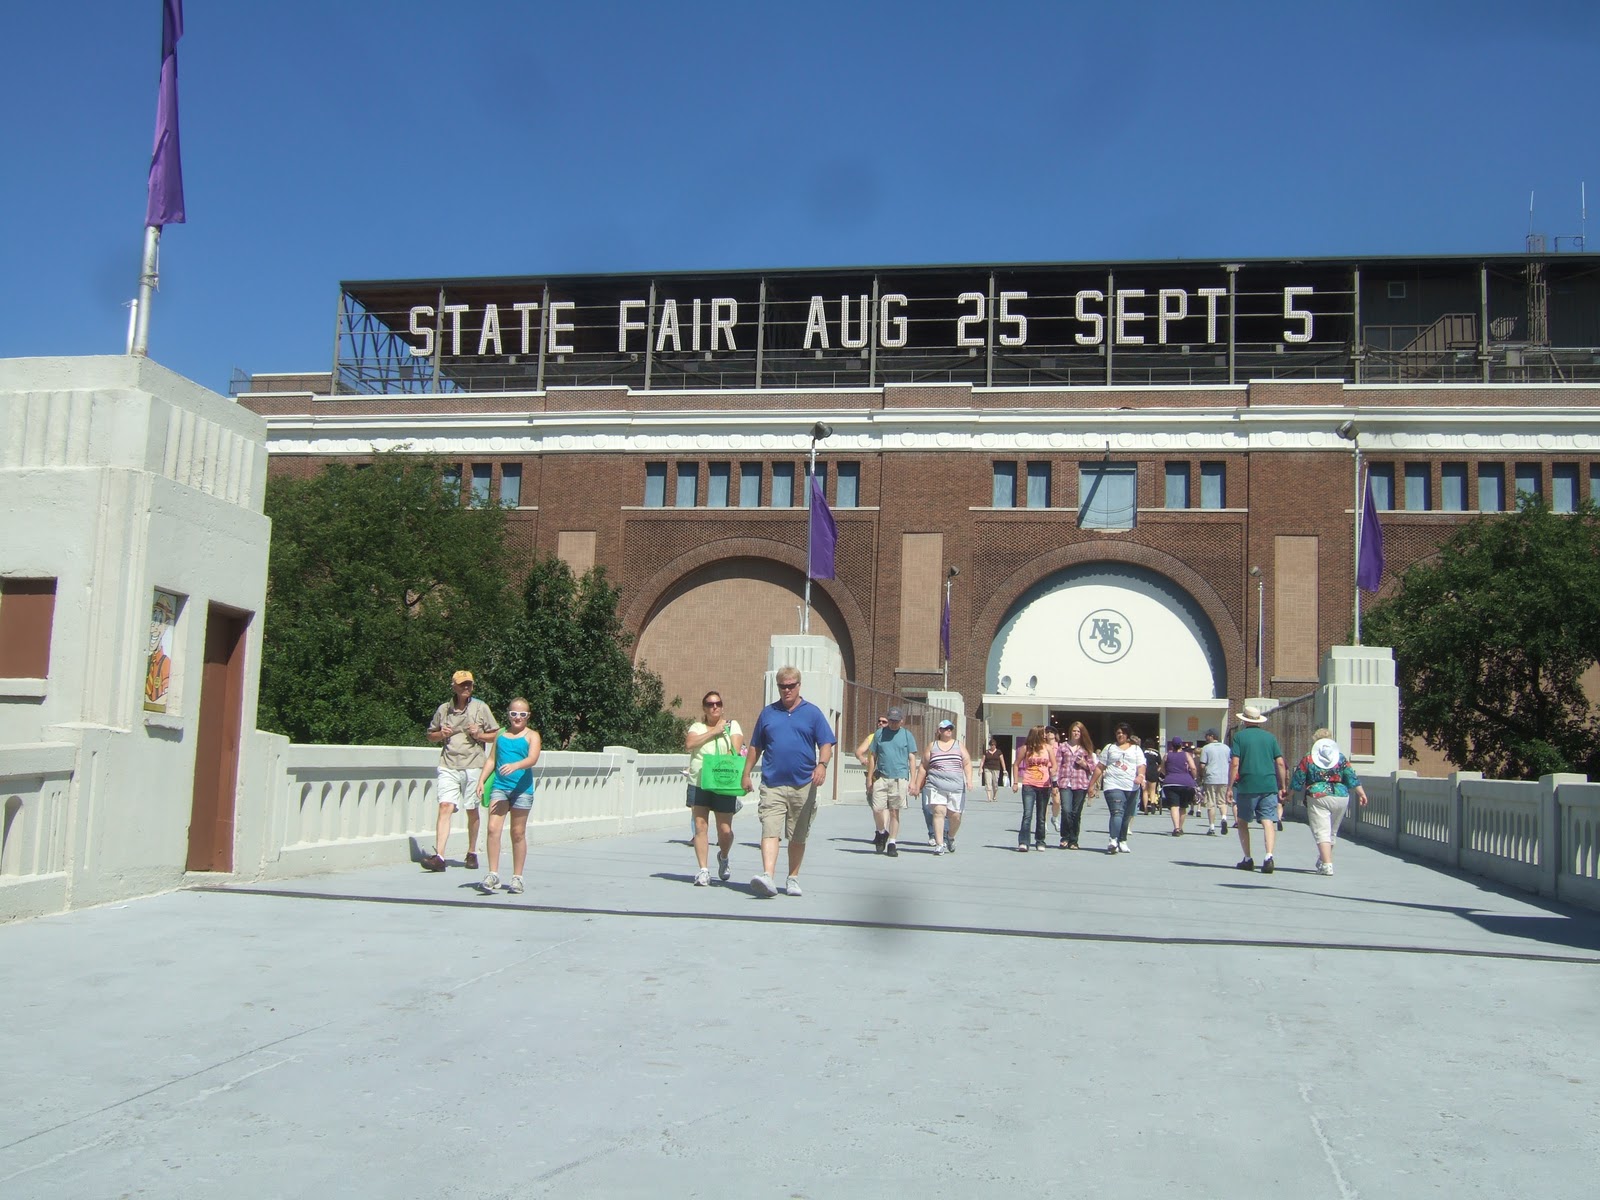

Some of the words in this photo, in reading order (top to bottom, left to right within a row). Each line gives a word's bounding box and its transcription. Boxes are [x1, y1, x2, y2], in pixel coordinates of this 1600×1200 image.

[409, 302, 575, 357] STATE
[618, 298, 738, 352] FAIR
[803, 295, 908, 348] AUG
[957, 292, 1028, 347] 25
[1075, 288, 1227, 346] SEPT
[1283, 286, 1314, 344] 5
